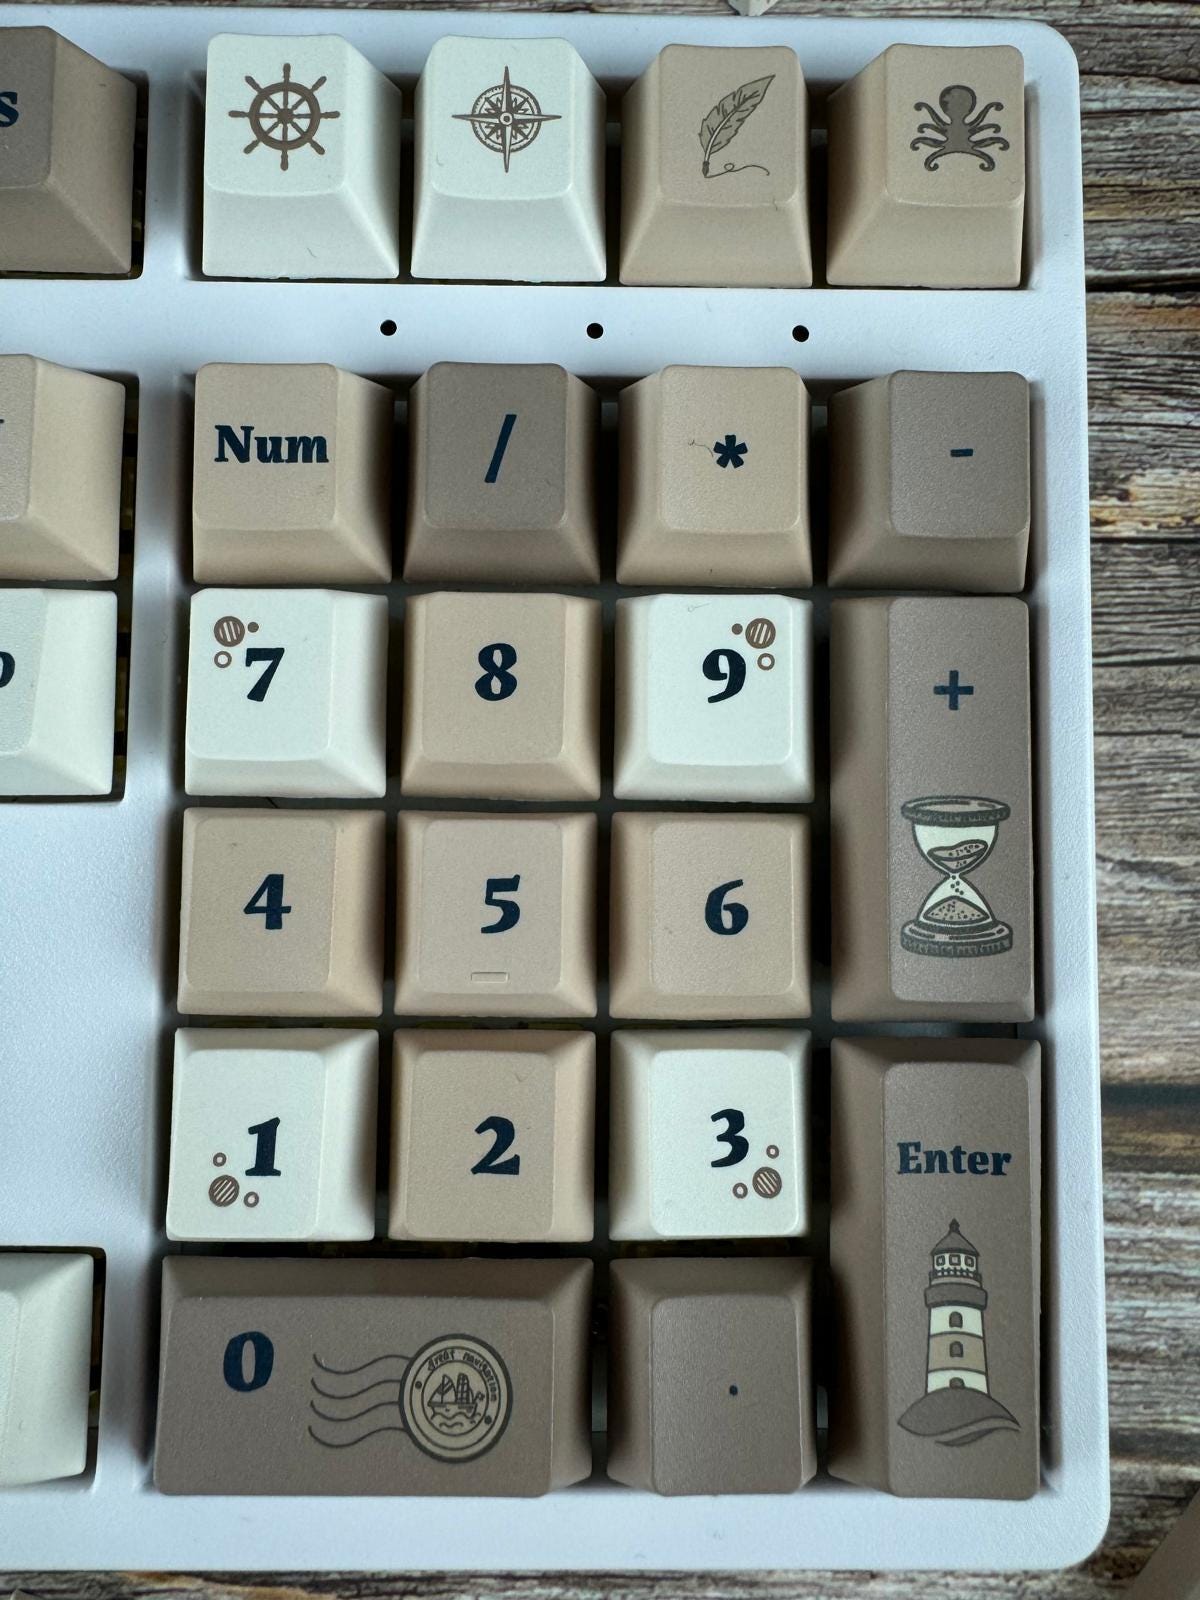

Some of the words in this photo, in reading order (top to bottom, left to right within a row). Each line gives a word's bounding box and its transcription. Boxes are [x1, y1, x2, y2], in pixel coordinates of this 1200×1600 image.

[214, 424, 329, 464] Num
[484, 413, 517, 483] /
[244, 647, 285, 702] 7
[474, 642, 517, 701] 8
[703, 648, 746, 703] 9
[933, 669, 974, 710] +
[243, 873, 291, 930] 4
[480, 874, 521, 933] 5
[704, 878, 748, 935] 6
[245, 1116, 281, 1176] 1
[470, 1115, 520, 1175] 2
[710, 1108, 749, 1167] 3
[897, 1141, 1012, 1175] Enter
[223, 1331, 274, 1392] 0
